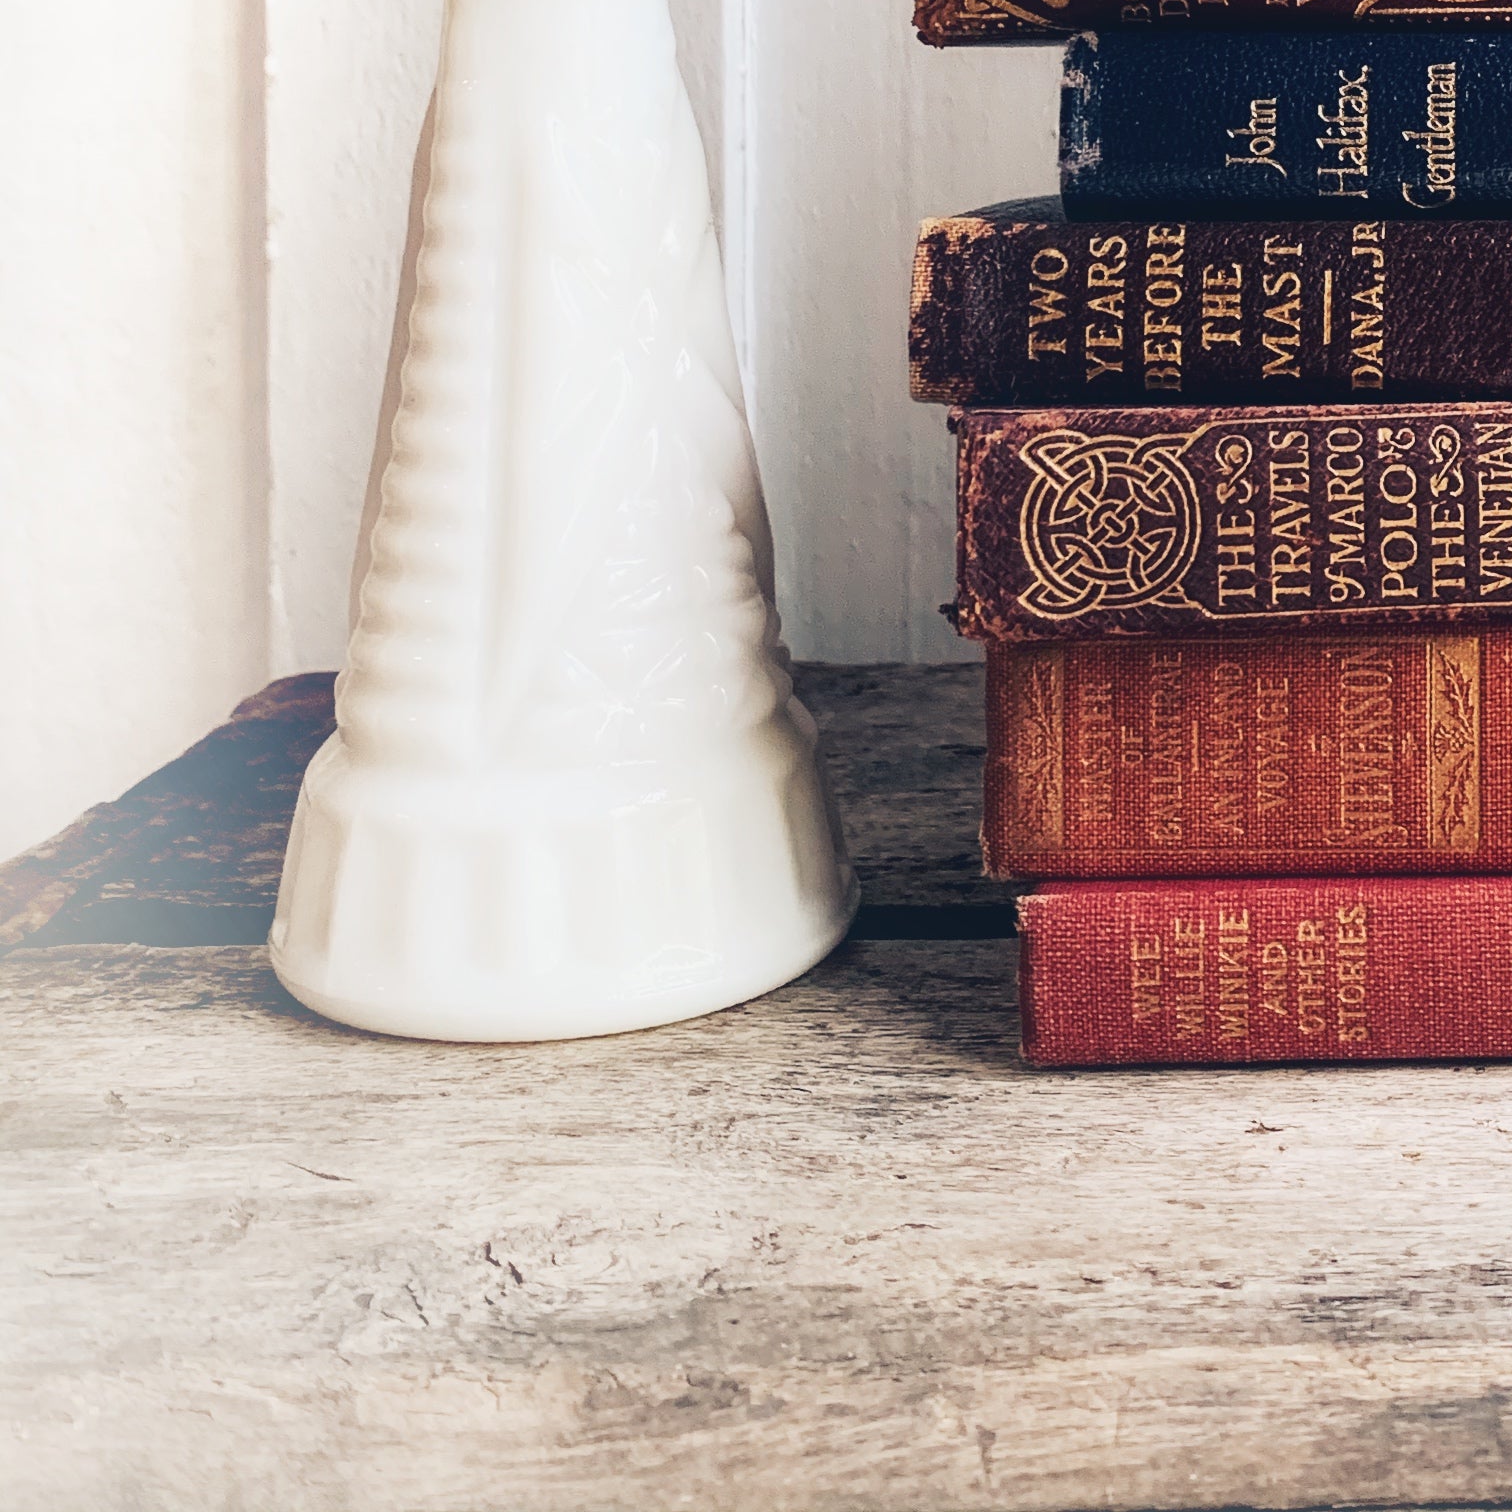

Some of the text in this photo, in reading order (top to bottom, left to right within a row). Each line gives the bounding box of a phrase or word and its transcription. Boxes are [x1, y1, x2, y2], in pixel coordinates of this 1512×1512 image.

[1225, 98, 1288, 178] John
[1402, 62, 1456, 209] Gentleman
[1028, 248, 1069, 361] TWO
[1085, 234, 1128, 383] YEARS
[1143, 223, 1186, 393] BEFORE
[1201, 262, 1242, 351] THE
[1261, 234, 1303, 380] MAST
[1216, 509, 1256, 607] THE
[1269, 430, 1311, 605] TRAVELS
[1324, 426, 1366, 603] of MARCO
[1379, 464, 1418, 599] POLO
[1431, 501, 1466, 598] THE
[1078, 682, 1113, 820] MASTER
[1121, 725, 1144, 764] OF
[1151, 651, 1182, 840] BALLANTRAE
[1211, 661, 1244, 835] AN INLAND
[1256, 677, 1289, 813] VOYAGE
[1322, 645, 1409, 846] STEVENSON
[1132, 934, 1161, 1023] WEE
[1175, 918, 1204, 1040] WILLIE
[1218, 909, 1249, 1040] WINKIE
[1261, 941, 1288, 1015] AND
[1298, 919, 1326, 1033] OTHER
[1336, 904, 1369, 1041] STORIES
